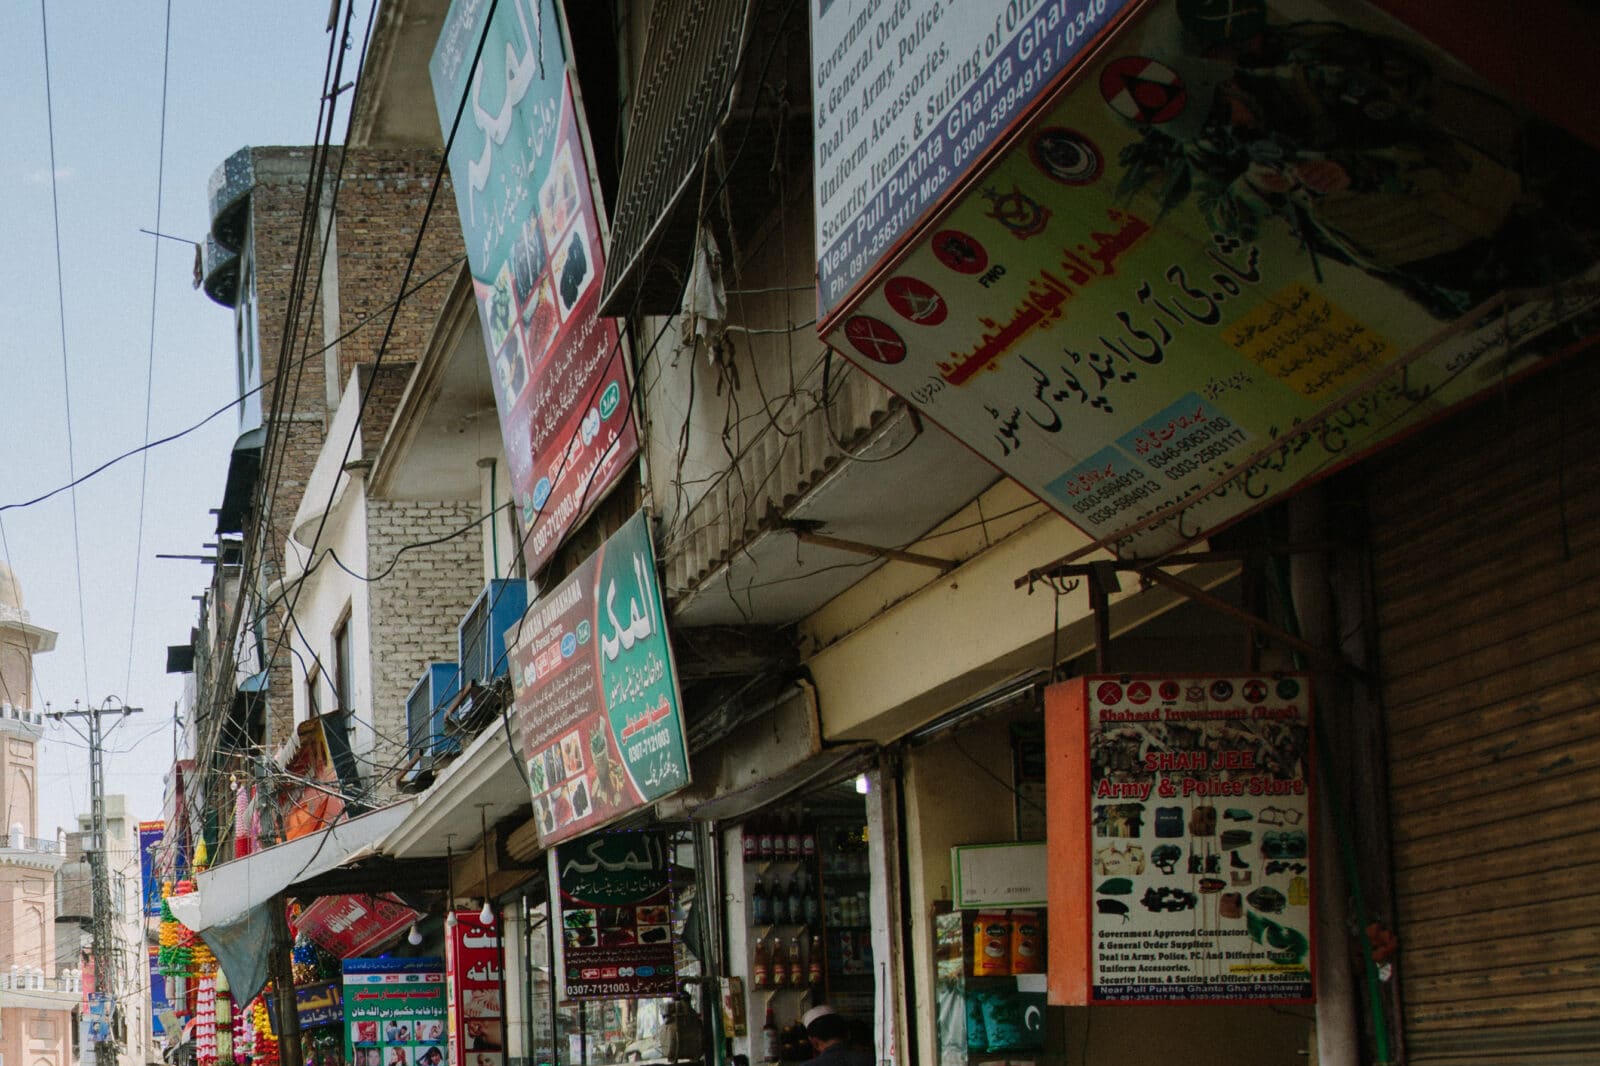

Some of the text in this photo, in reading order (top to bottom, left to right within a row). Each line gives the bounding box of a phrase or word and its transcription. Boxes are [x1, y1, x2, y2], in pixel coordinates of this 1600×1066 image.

[818, 0, 882, 88] Governmen
[829, 37, 874, 115] General
[819, 120, 844, 168] Deal
[847, 105, 859, 135] in
[821, 178, 868, 248] Security
[913, 111, 923, 141] &
[926, 44, 982, 127] Suiting
[984, 14, 1002, 58] of
[822, 232, 854, 281] Near
[857, 190, 885, 243] Pull
[888, 134, 944, 208] Pukhta
[947, 56, 1013, 140] Ghanta
[1017, 0, 1066, 62] Ghar
[820, 137, 868, 208] Uniform
[850, 191, 918, 279] 091-2563117
[978, 264, 1007, 288] FWO
[1144, 750, 1256, 770] SHAH JEE
[1098, 775, 1305, 799] Army & Police Store
[562, 832, 663, 879] المکہ
[1098, 928, 1248, 939] Government Approved Contractors
[1106, 941, 1141, 950] General
[1143, 941, 1168, 949] Order
[1099, 953, 1118, 961] Deal
[1206, 951, 1223, 960] And
[1225, 950, 1265, 960] Different
[1099, 964, 1136, 973] Uniform
[1099, 976, 1135, 985] Security
[1175, 974, 1208, 984] Suiting
[1210, 974, 1220, 983] of
[567, 982, 631, 996] 0307-7121003
[1100, 983, 1304, 994] Near Pull Pukhta Ghanta Ghar Peshawar
